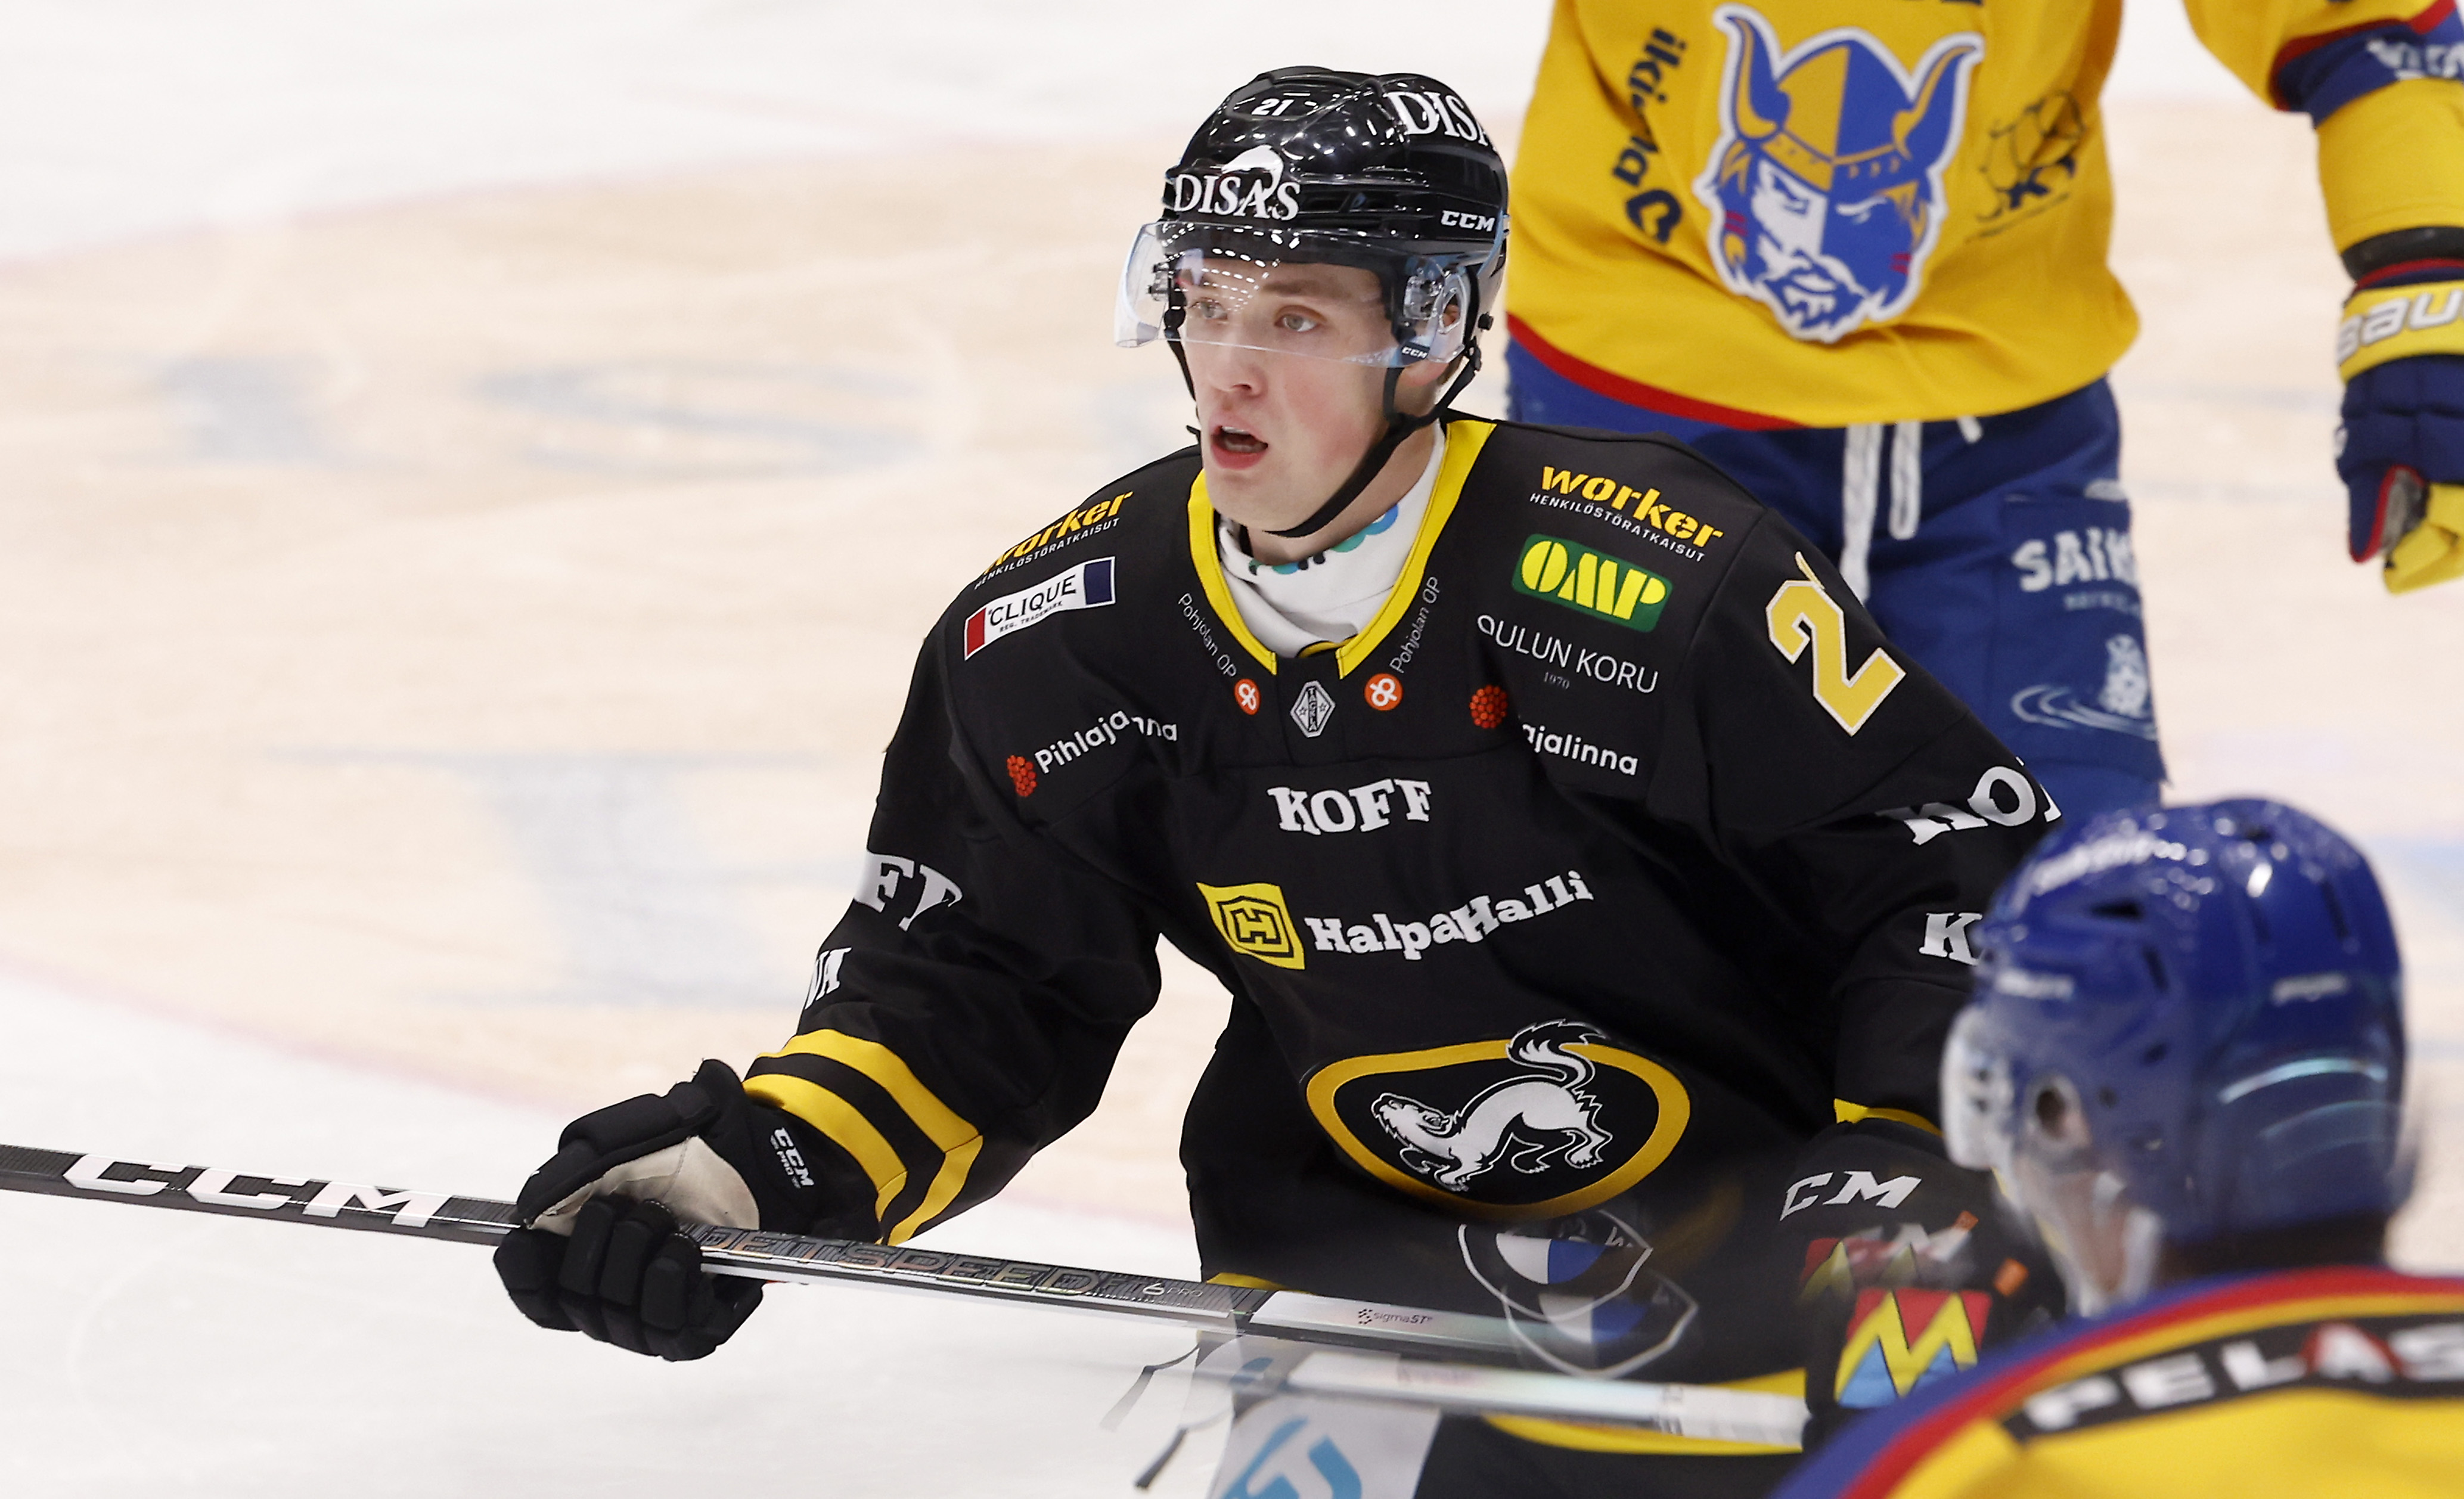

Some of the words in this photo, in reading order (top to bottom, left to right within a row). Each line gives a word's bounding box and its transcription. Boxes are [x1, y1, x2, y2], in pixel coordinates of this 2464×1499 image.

[1252, 98, 1294, 116] 21
[1173, 173, 1301, 221] DISAS
[1441, 210, 1495, 232] CCM
[1402, 346, 1427, 358] CCM
[1529, 493, 1705, 563] HENKILÖSTÖRATKAISUT
[1541, 466, 1724, 549] worker
[989, 575, 1076, 626] CLIQUE
[1521, 541, 1667, 620] OMP
[1021, 600, 1063, 625] TRADEMARK
[1178, 592, 1219, 656] Pohjolan
[1217, 654, 1237, 677] OP
[1389, 607, 1429, 674] Pohjolan
[1422, 576, 1440, 604] OP
[1575, 648, 1659, 694] KORU
[1267, 778, 1432, 835] KOFF
[1305, 870, 1594, 960] HalpaHalli
[774, 1126, 815, 1186] CCM
[63, 1154, 454, 1228] CCM
[1166, 1287, 1204, 1298] PRO
